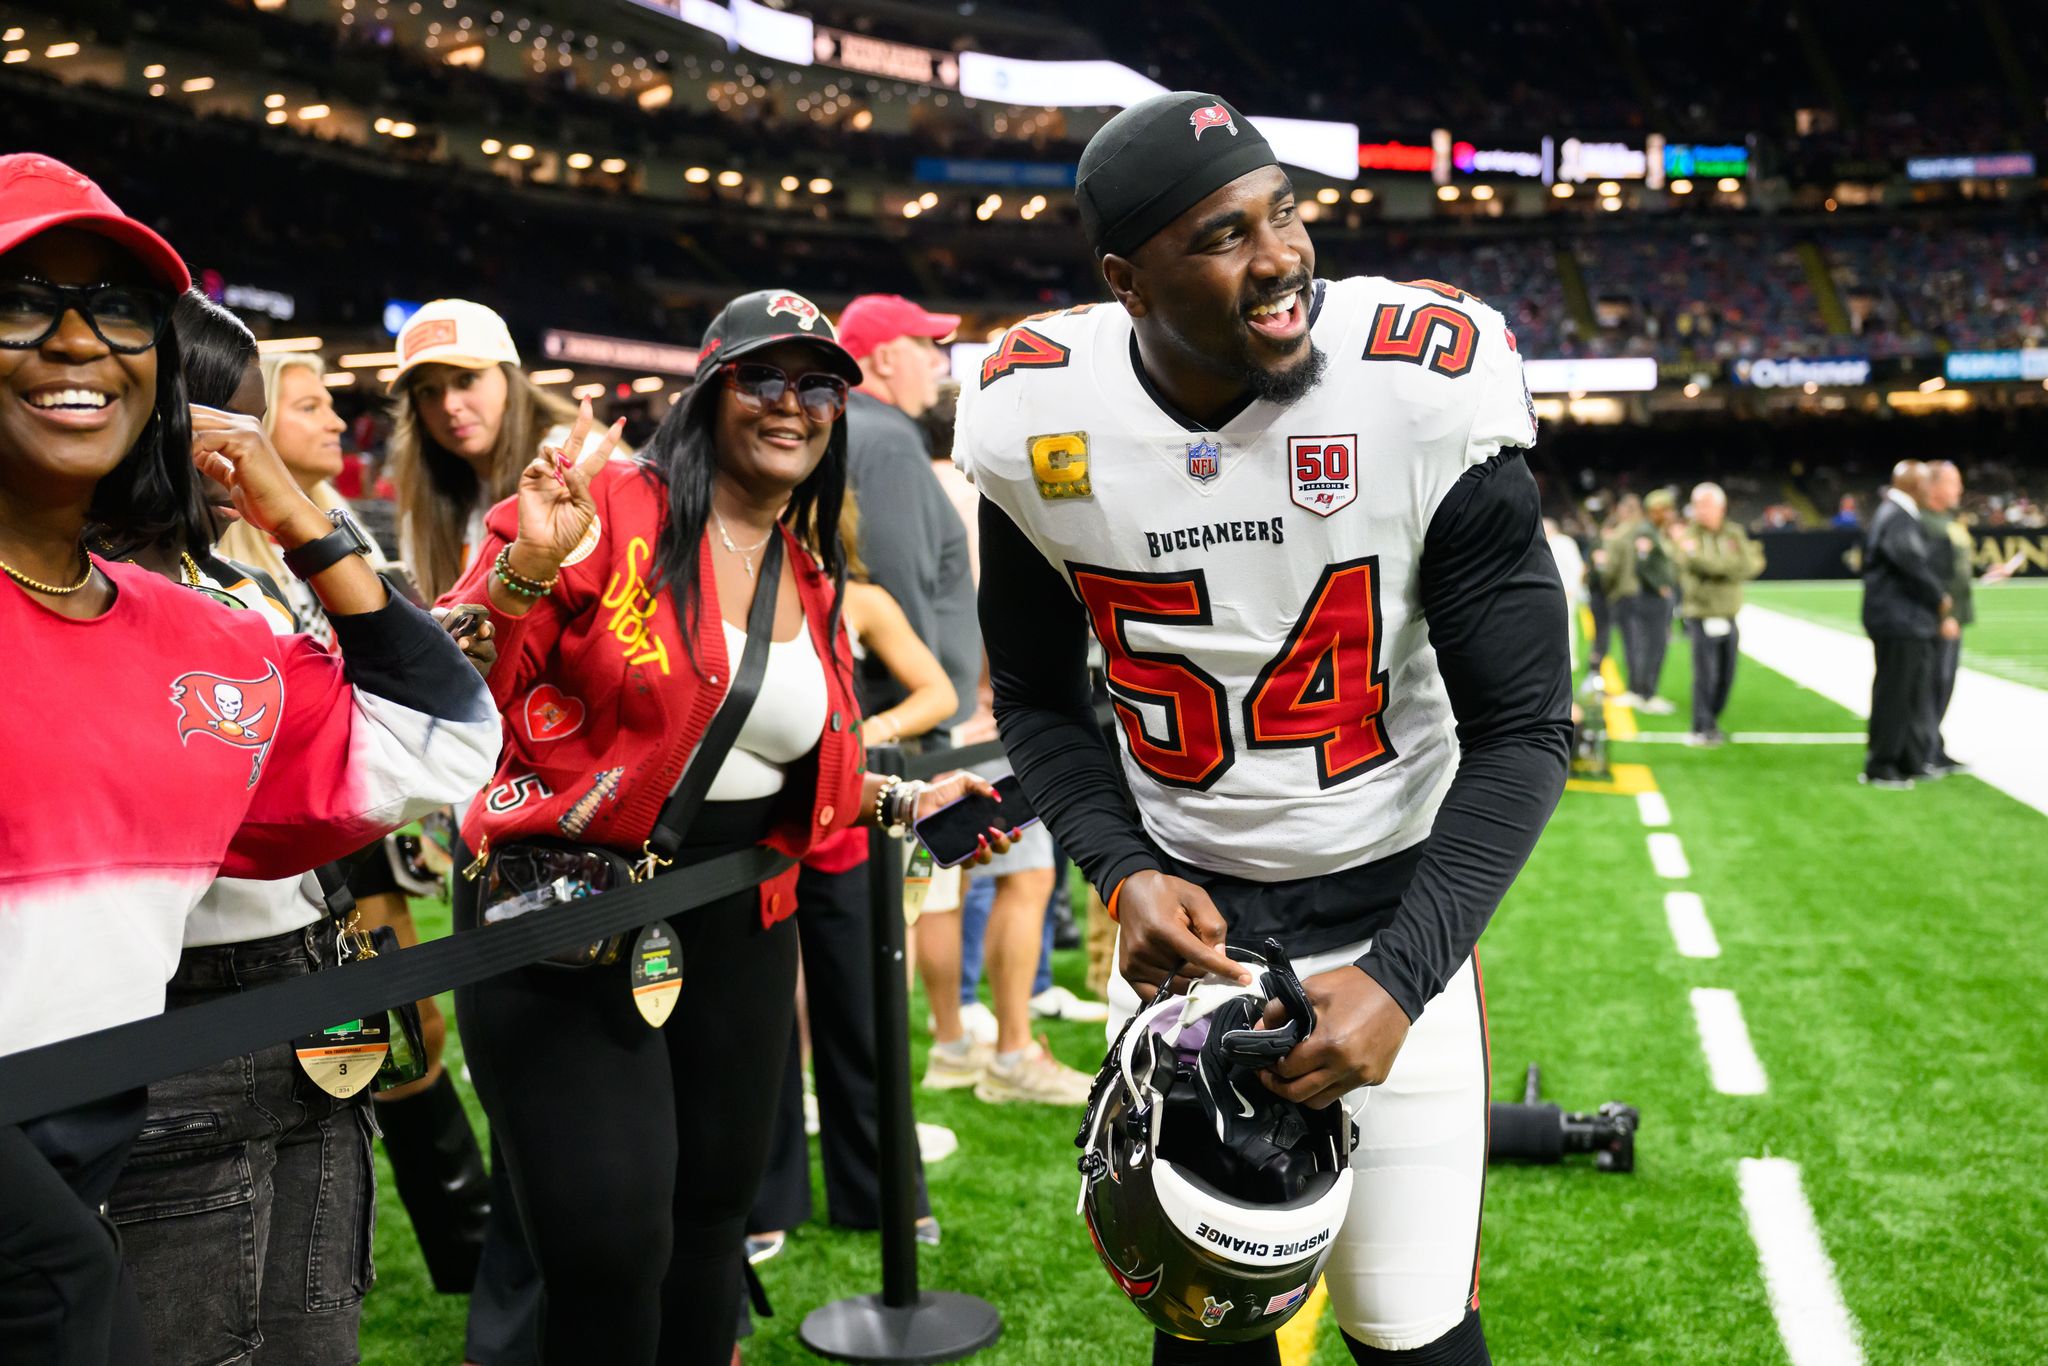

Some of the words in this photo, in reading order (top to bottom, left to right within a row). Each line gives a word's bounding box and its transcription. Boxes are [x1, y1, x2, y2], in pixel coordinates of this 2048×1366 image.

[1191, 458, 1215, 475] NFL
[1296, 444, 1350, 482] 50
[1144, 517, 1284, 558] BUCCANEERS
[1064, 555, 1399, 792] 54
[486, 773, 554, 814] 5
[339, 1063, 348, 1075] 3
[1195, 1222, 1269, 1257] CHANGE
[1272, 1228, 1330, 1257] INSPIRE
